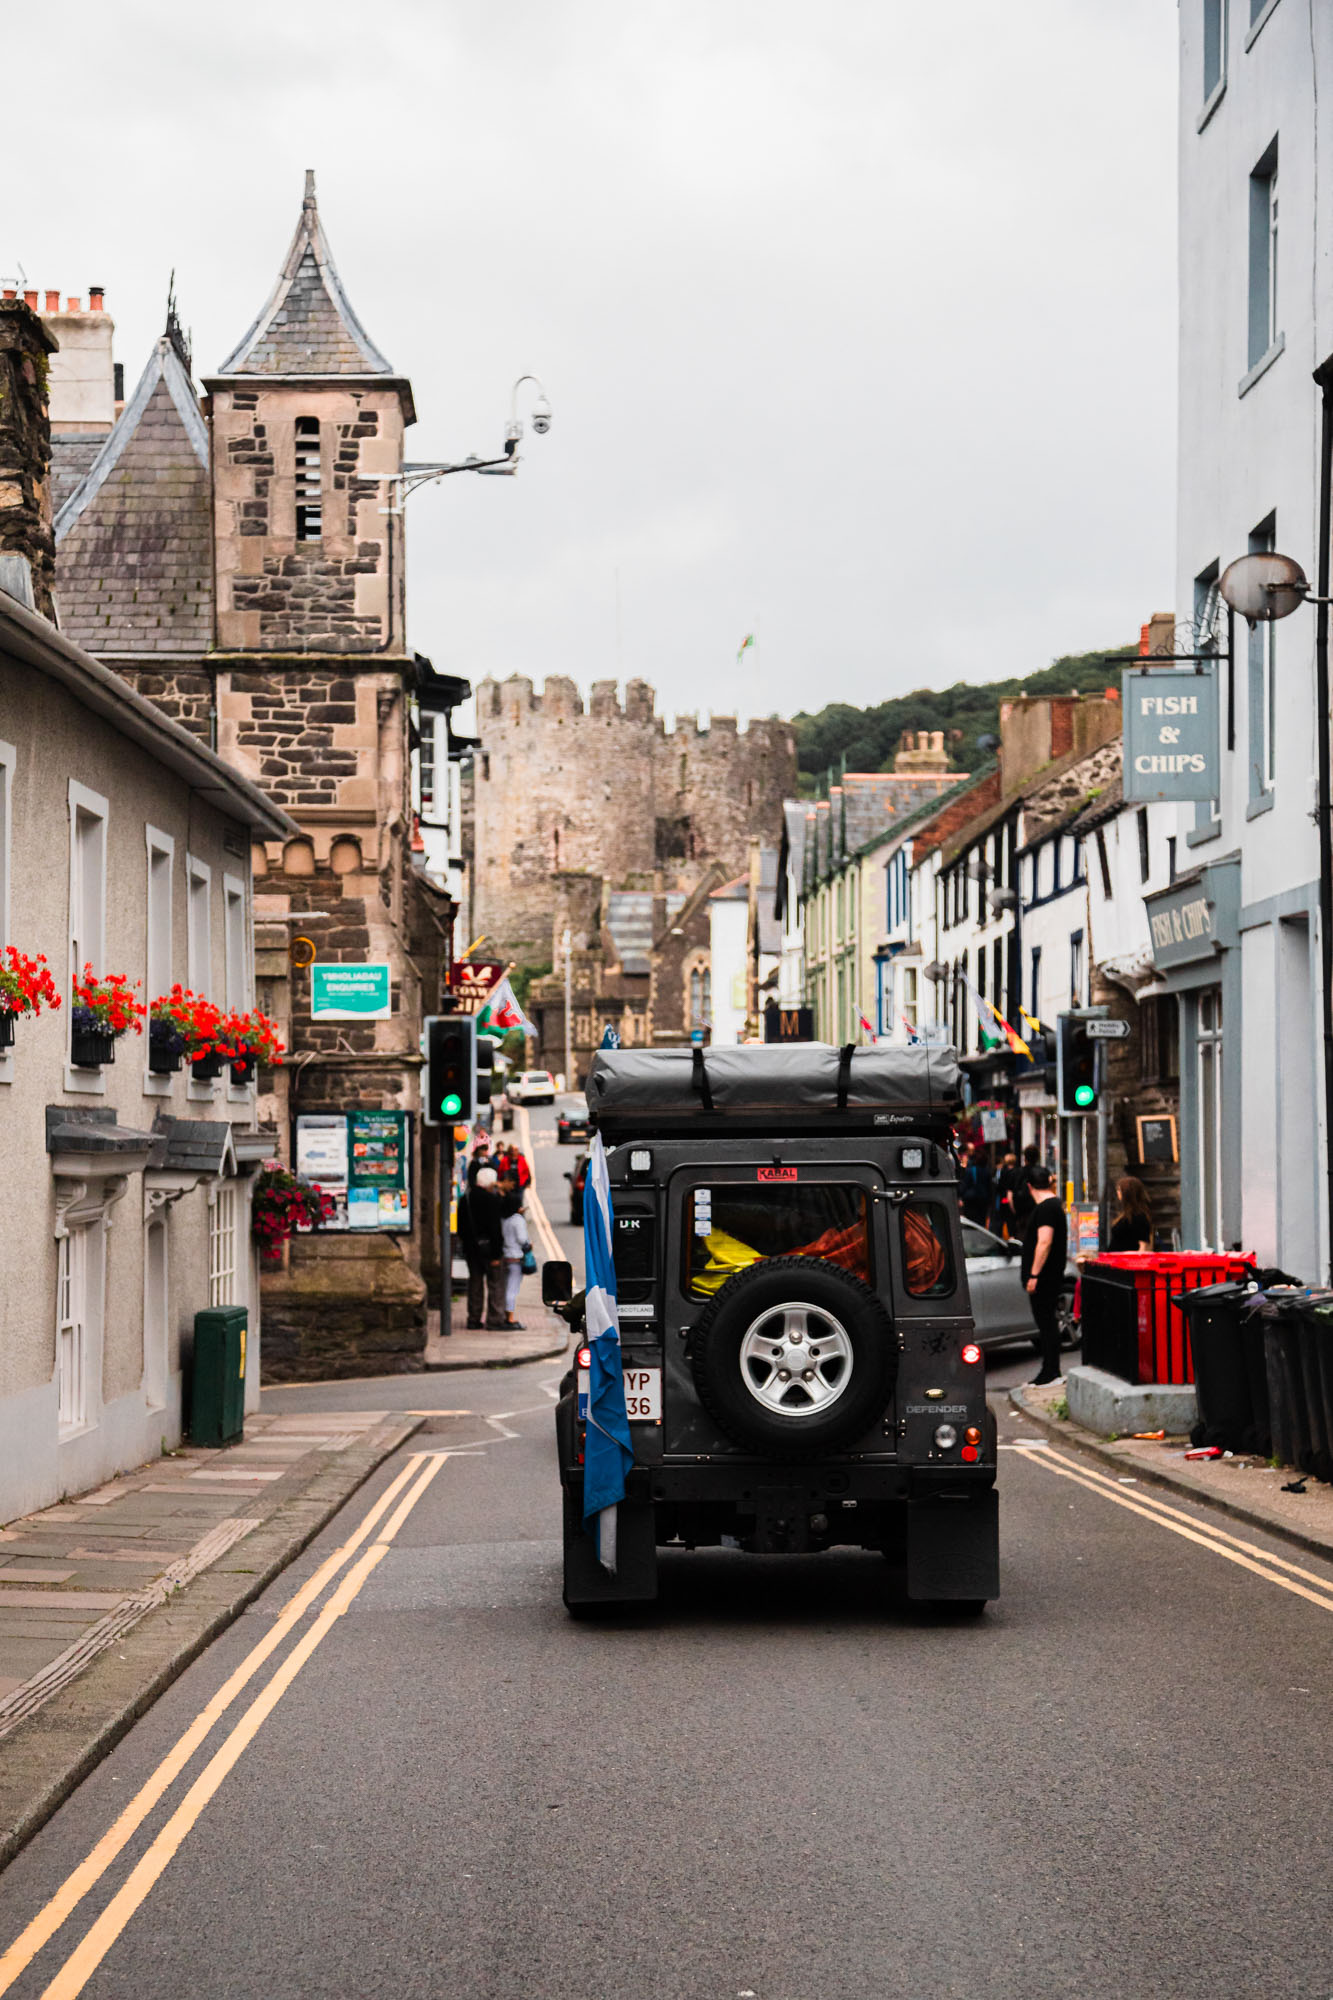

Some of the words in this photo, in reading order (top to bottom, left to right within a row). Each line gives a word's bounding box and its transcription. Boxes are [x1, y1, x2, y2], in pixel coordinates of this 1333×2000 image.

[1141, 696, 1198, 715] FISH
[1159, 726, 1180, 744] &
[1135, 754, 1206, 773] CHIPS
[1151, 912, 1174, 948] FISH
[1172, 909, 1184, 942] &
[1181, 899, 1211, 939] CHIPS
[452, 985, 488, 997] CONW
[760, 1169, 795, 1179] KABAL
[627, 1373, 650, 1390] YP
[627, 1397, 650, 1415] 36
[906, 1405, 967, 1413] DEFENDER
